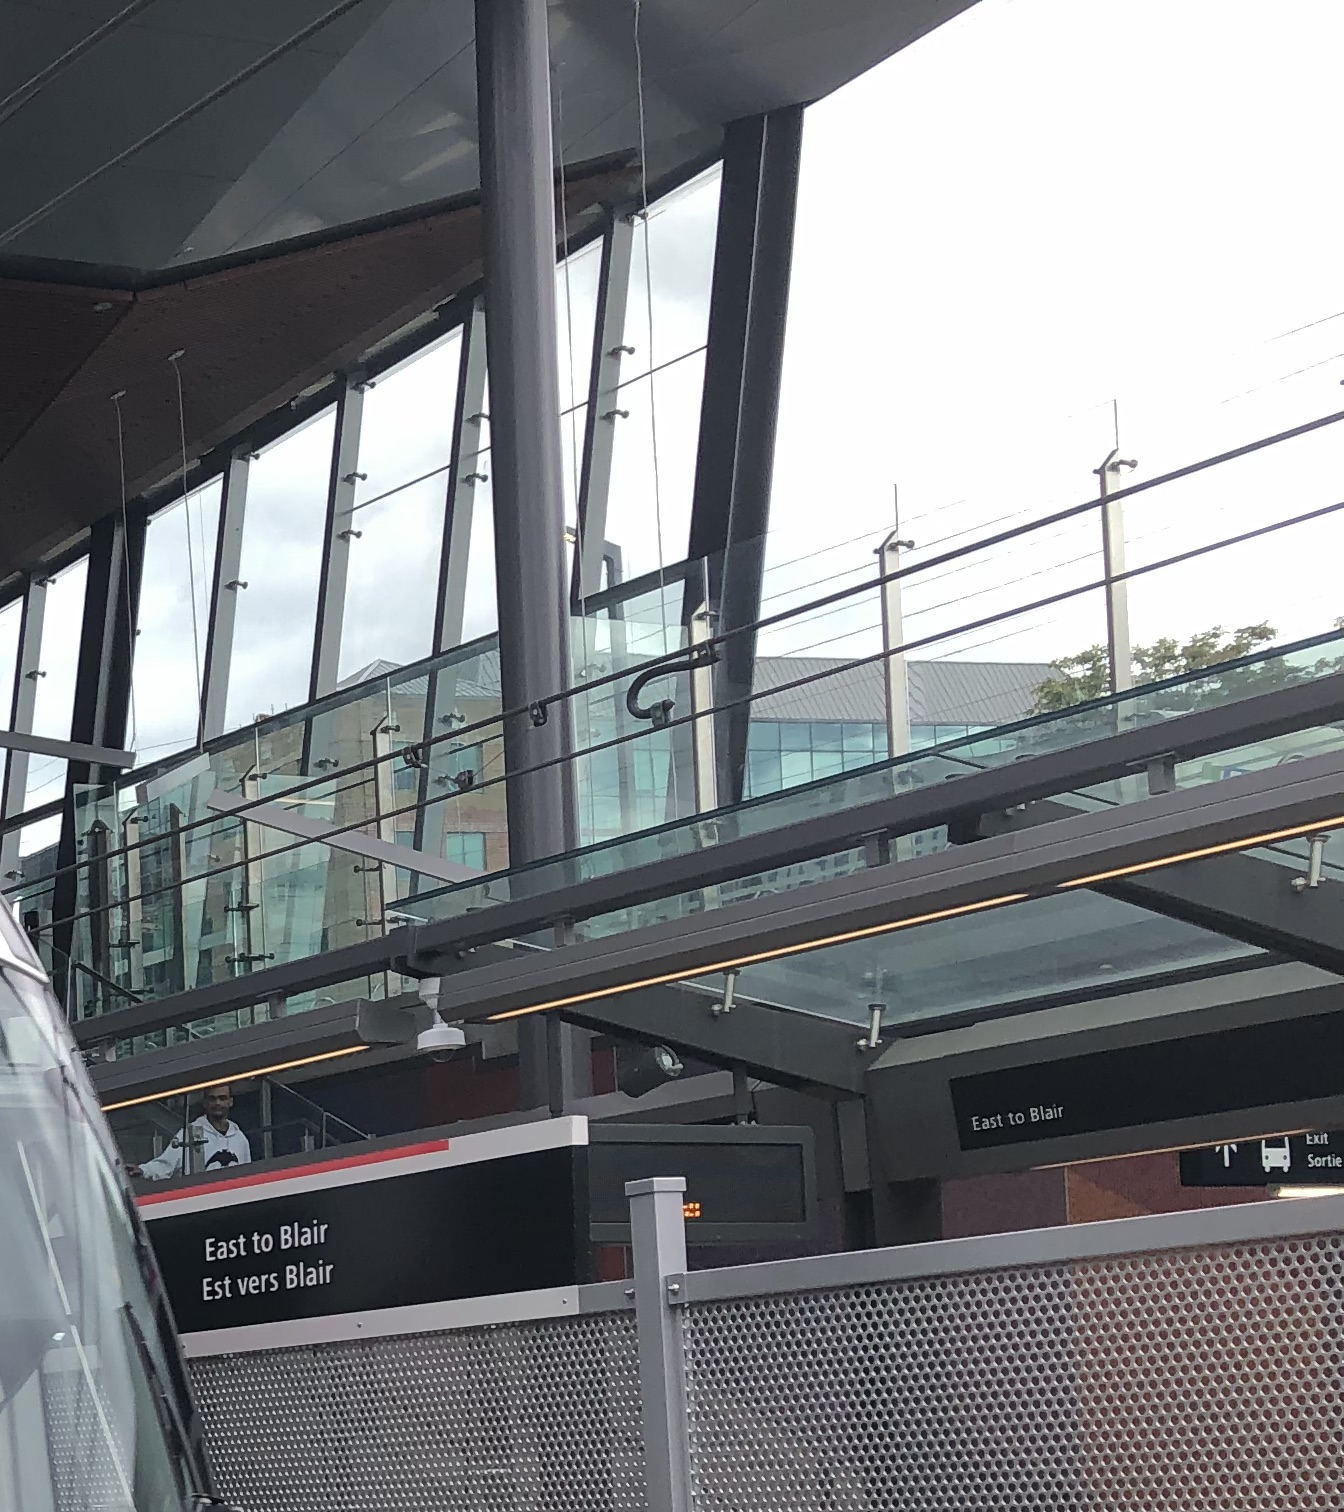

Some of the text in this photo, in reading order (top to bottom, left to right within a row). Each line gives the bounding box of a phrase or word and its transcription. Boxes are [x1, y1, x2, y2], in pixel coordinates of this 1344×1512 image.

[971, 1103, 1064, 1131] East to Blair
[1306, 1131, 1329, 1145] Exit
[1307, 1153, 1343, 1168] Sortie
[205, 1218, 329, 1262] East to Blair
[202, 1259, 334, 1301] Est vers Blair
